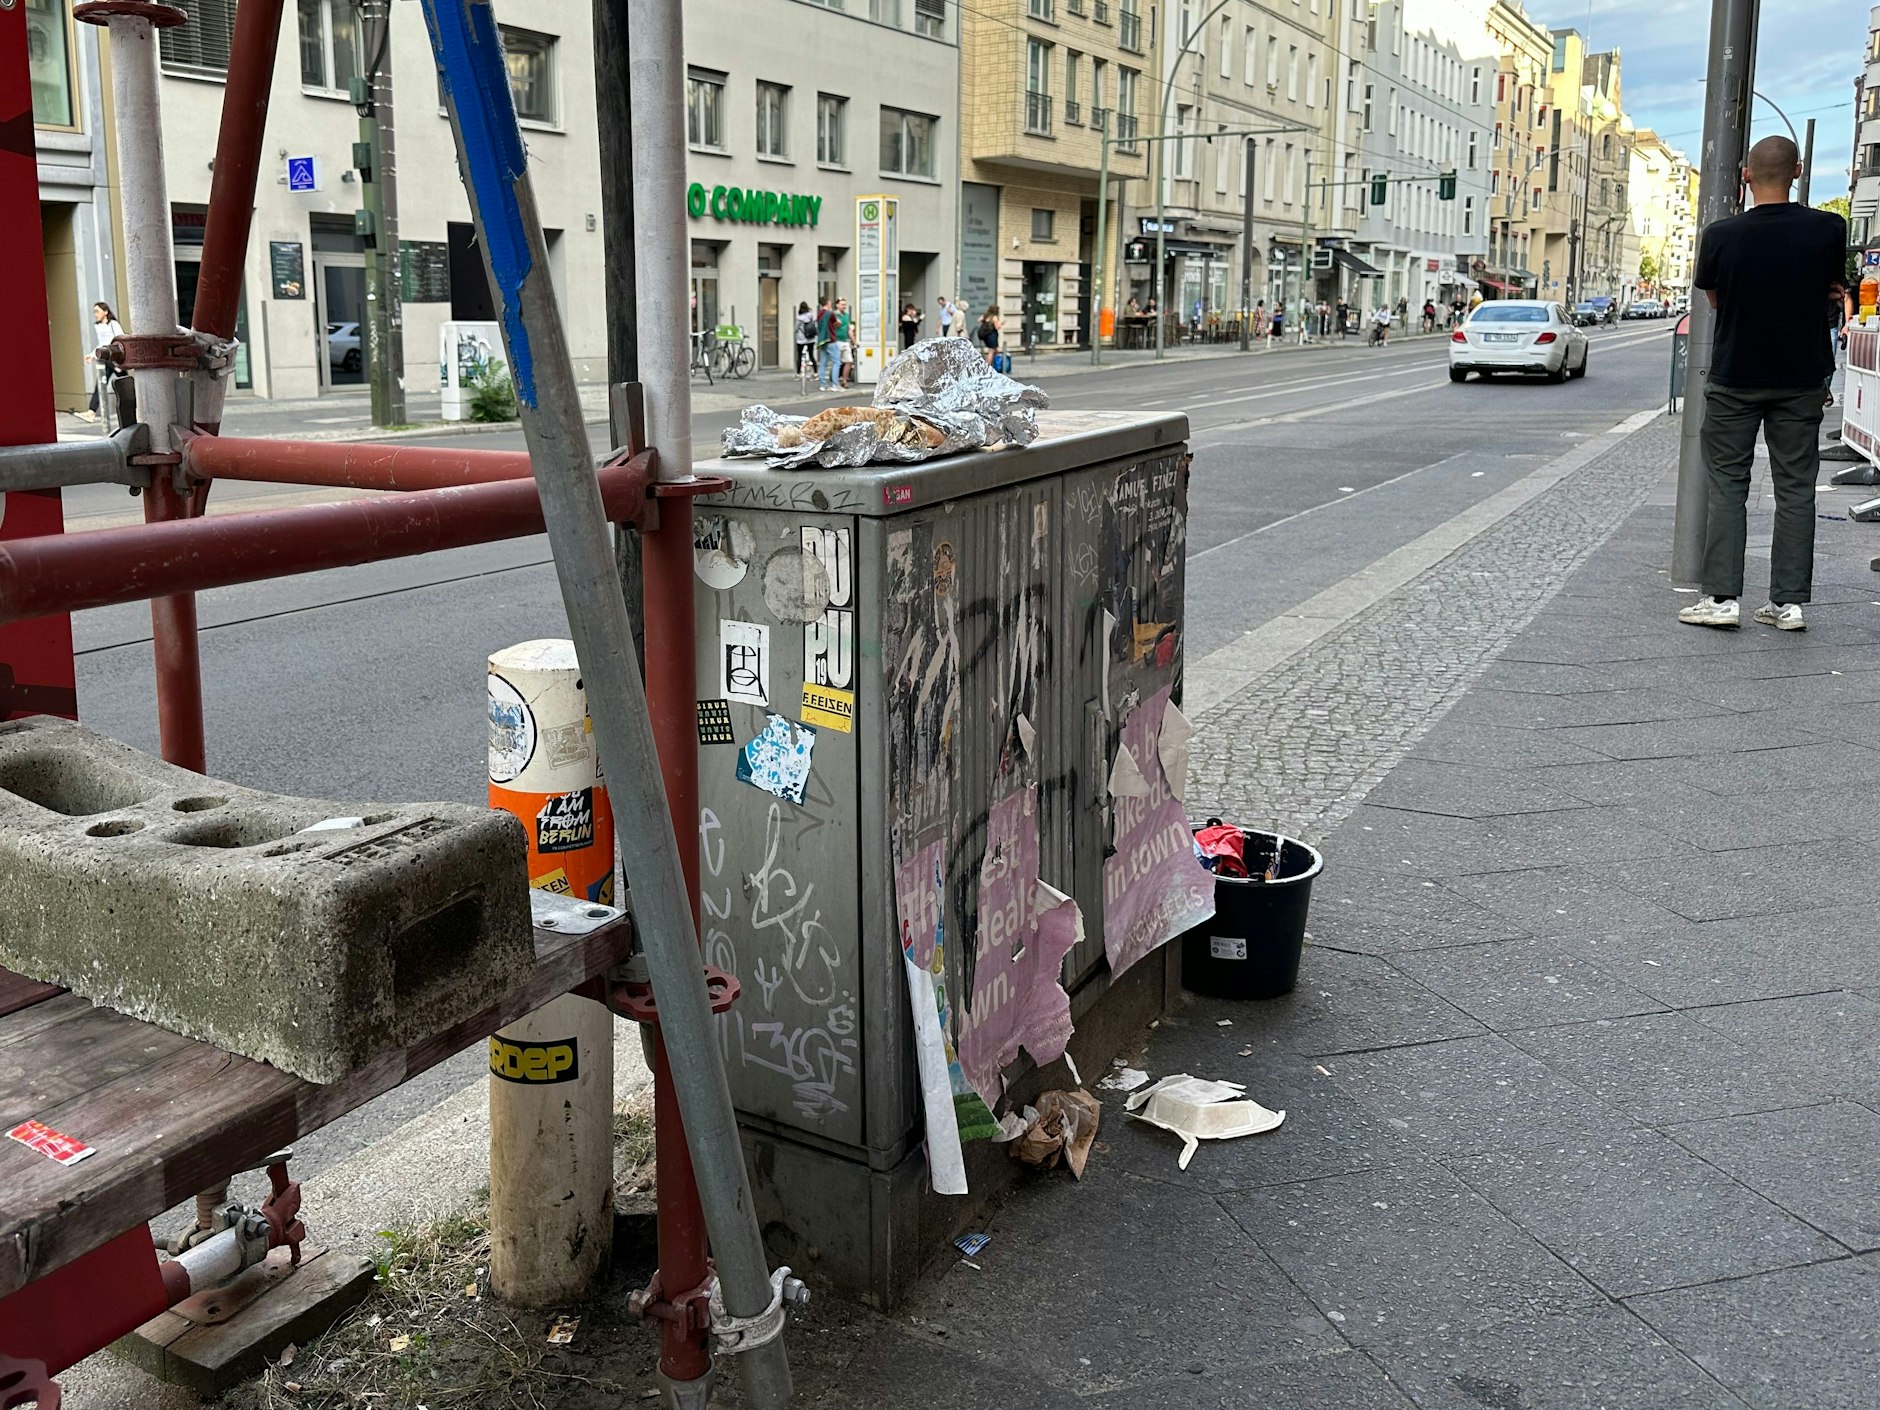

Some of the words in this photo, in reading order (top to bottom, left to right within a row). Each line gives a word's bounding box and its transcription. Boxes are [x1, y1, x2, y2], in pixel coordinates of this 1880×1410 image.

[711, 185, 822, 226] COMPANY
[1153, 470, 1178, 493] FINZI
[815, 658, 827, 686] 19
[696, 701, 727, 710] SIRUR
[699, 717, 730, 725] SIRUR
[701, 733, 732, 742] SIRUR
[556, 796, 585, 815] AM
[540, 809, 591, 831] FROM
[539, 823, 592, 846] BERLIN
[1107, 861, 1128, 905] in
[1130, 819, 1190, 884] town
